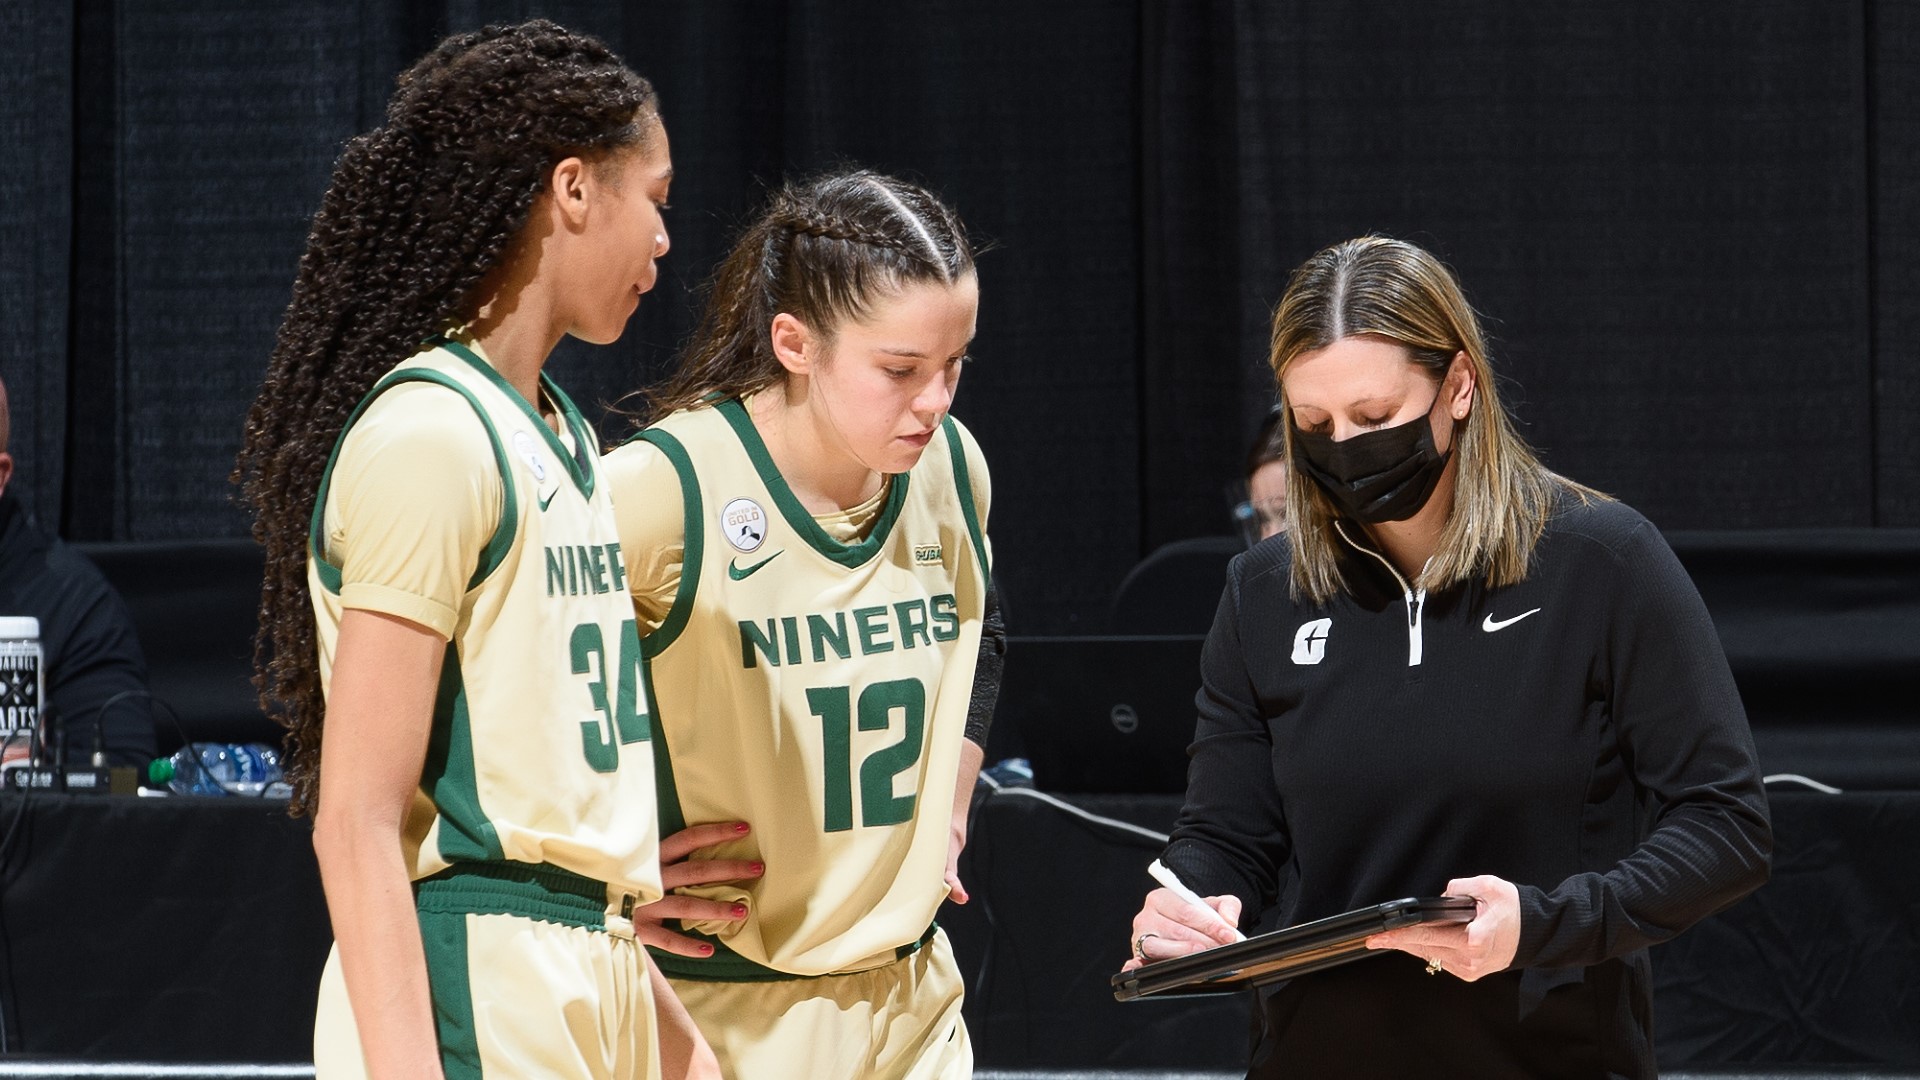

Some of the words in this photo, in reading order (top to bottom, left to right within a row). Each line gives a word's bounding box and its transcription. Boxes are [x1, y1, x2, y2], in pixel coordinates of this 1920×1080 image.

[728, 511, 759, 526] GOLD
[738, 594, 960, 668] NINERS
[570, 619, 651, 773] 34
[805, 677, 926, 833] 12
